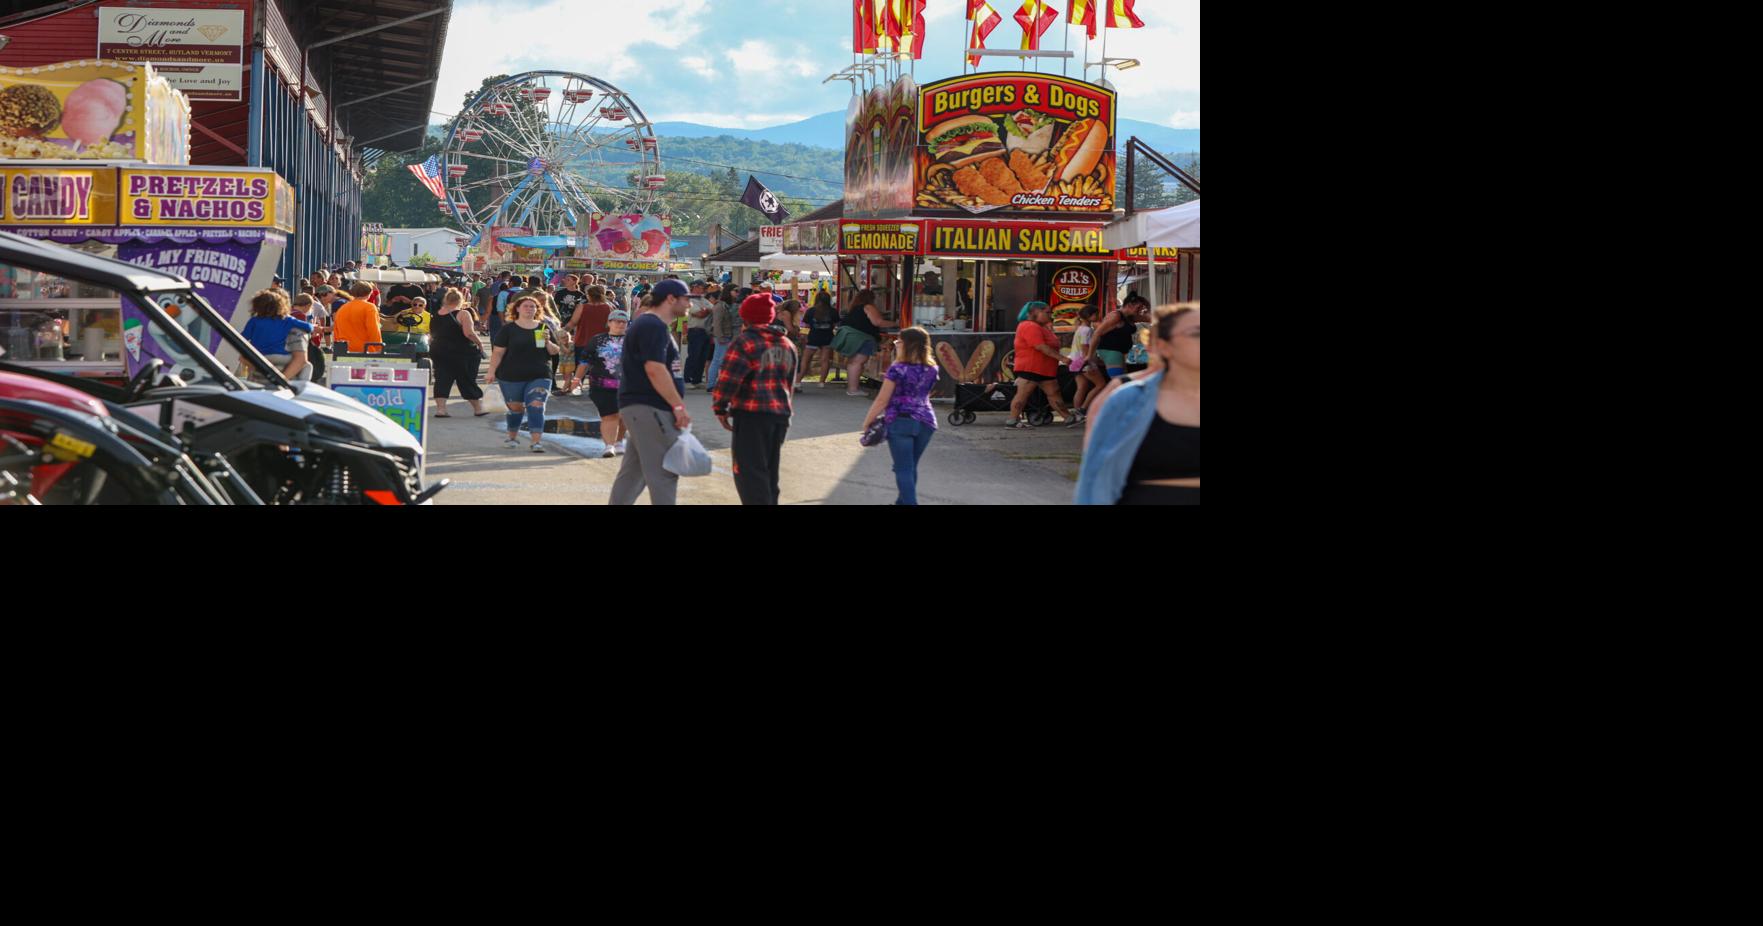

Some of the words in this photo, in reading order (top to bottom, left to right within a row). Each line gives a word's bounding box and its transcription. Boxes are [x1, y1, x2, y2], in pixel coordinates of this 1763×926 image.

[114, 13, 196, 33] Diamonds
[127, 30, 181, 47] More
[218, 78, 231, 86] Joy
[934, 84, 1016, 114] Burgers
[1024, 84, 1040, 105] &
[1050, 84, 1099, 117] Dogs
[129, 174, 269, 198] PRETZELS
[12, 174, 92, 219] CANDY
[1011, 194, 1055, 206] Chicken
[1058, 195, 1101, 206] Tenders
[133, 198, 151, 219] &
[159, 199, 265, 221] NACHOS
[761, 226, 784, 238] FRIE
[847, 233, 914, 250] LEMONADE
[935, 226, 1012, 251] ITALIAN
[1128, 245, 1177, 257] DRNKS
[158, 249, 182, 265] MY
[184, 249, 247, 275] FRIENDS
[191, 265, 244, 291] CONES!
[1060, 287, 1088, 296] GRILLE
[367, 389, 404, 407] cold
